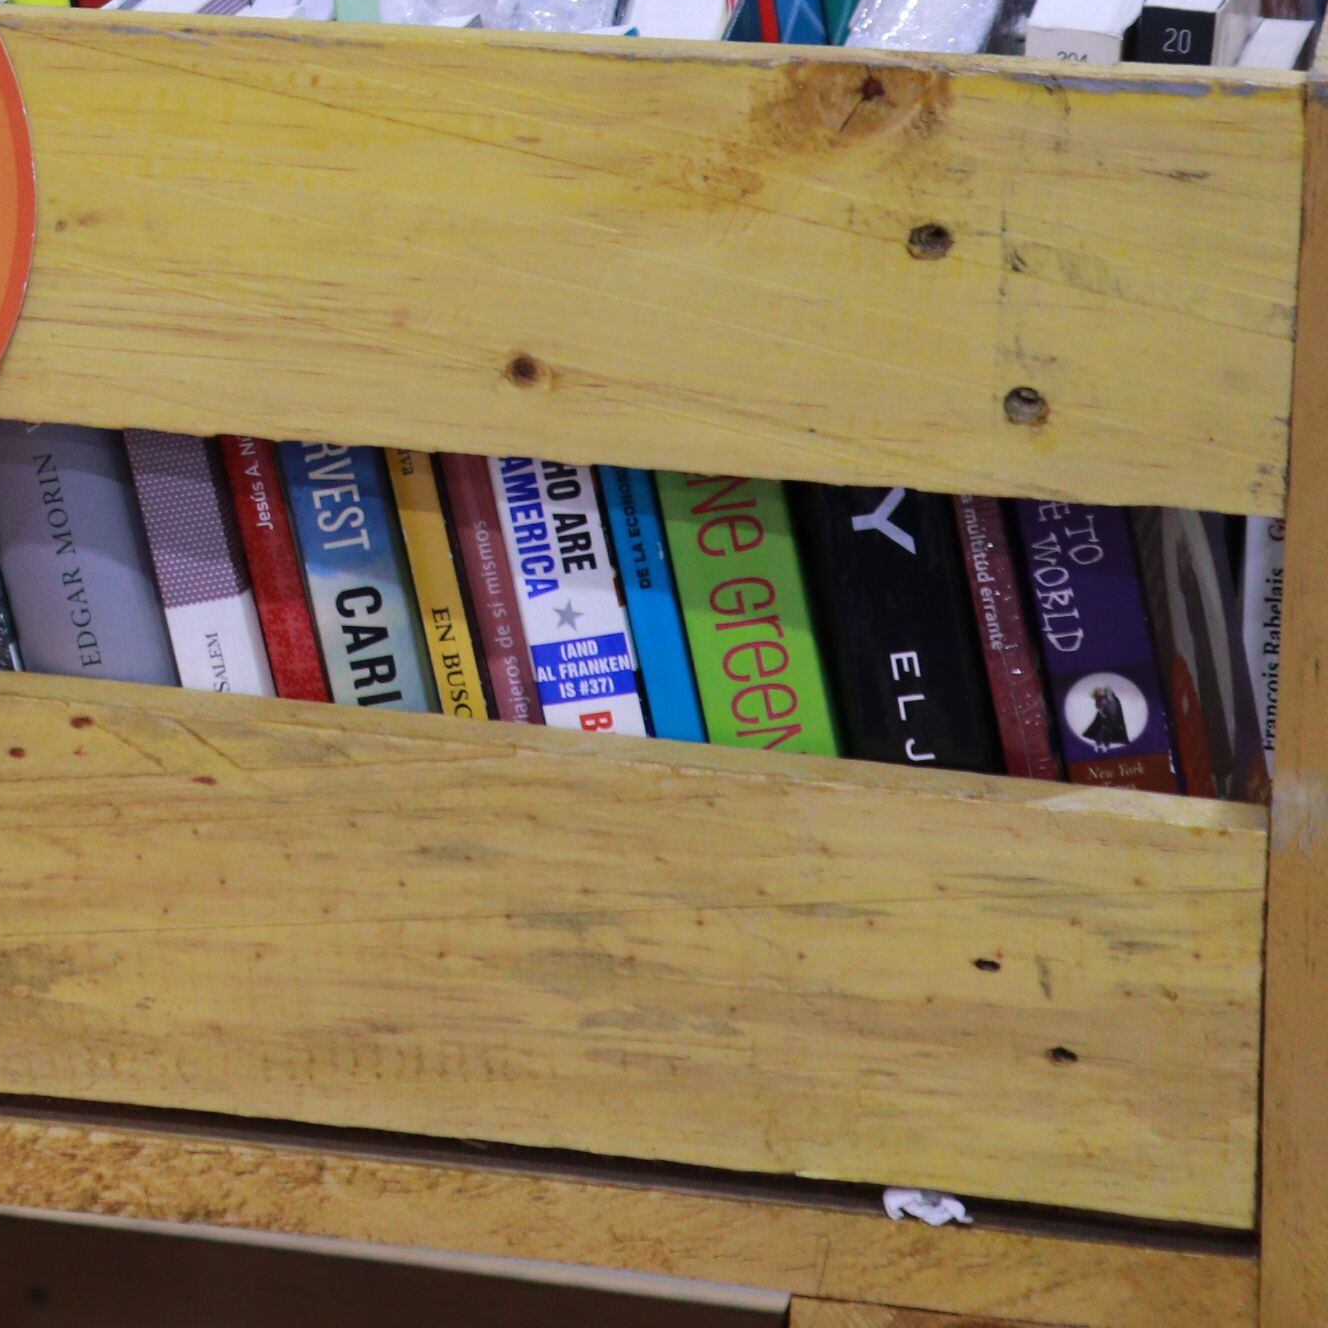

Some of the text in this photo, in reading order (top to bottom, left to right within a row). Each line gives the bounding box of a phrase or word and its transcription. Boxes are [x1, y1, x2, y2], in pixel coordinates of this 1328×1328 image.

[1162, 26, 1193, 55] 20
[244, 458, 275, 531] Jesús A.
[496, 456, 560, 600] AMERICA
[552, 512, 598, 574] ARE
[1065, 515, 1104, 565] TO
[32, 453, 103, 668] EDGAR MORIN
[473, 518, 504, 596] mismos
[631, 541, 652, 590] DE LA
[963, 507, 1005, 651] multitud errante
[490, 602, 508, 621] sí
[1031, 531, 1085, 654] WORLD
[431, 607, 457, 643] EN
[493, 625, 513, 648] de
[537, 652, 632, 683] AL FRANKEN
[559, 641, 600, 662] (AND
[559, 678, 615, 699] IS #37)
